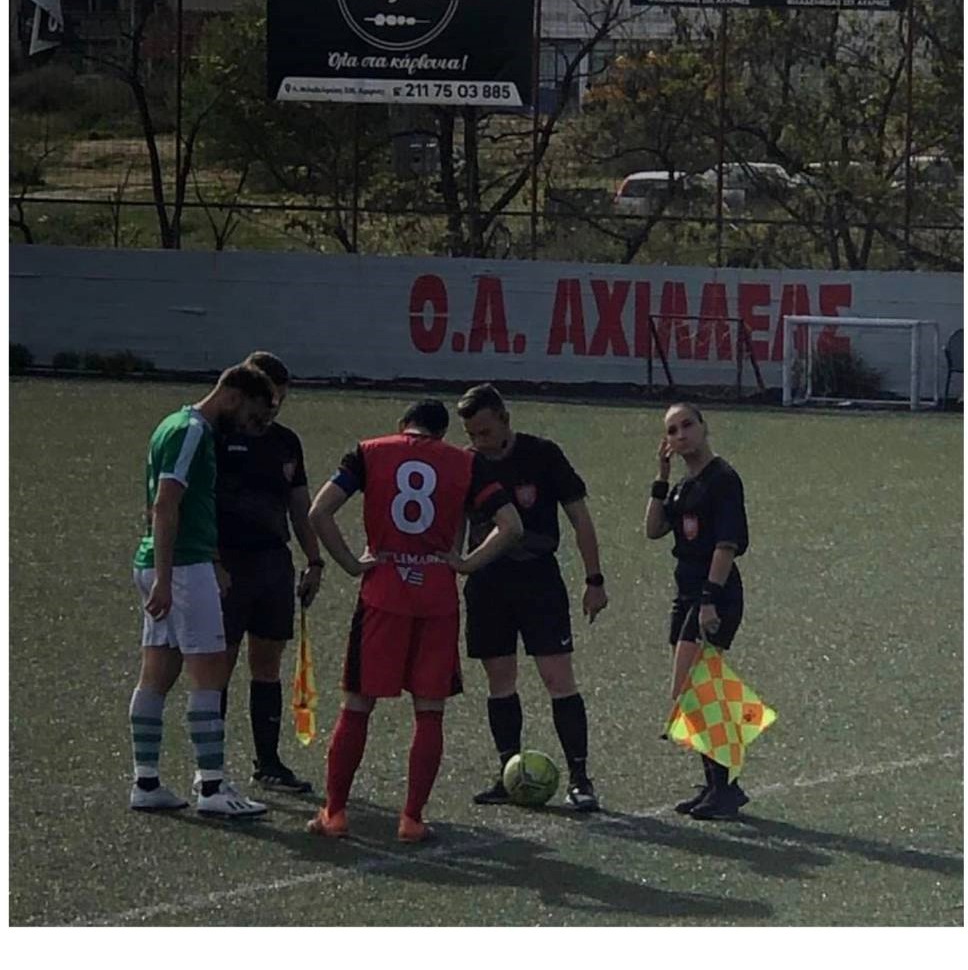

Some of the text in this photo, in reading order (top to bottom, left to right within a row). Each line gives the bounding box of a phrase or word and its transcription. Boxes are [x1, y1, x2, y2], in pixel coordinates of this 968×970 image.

[405, 83, 512, 100] 211 75 03 885
[391, 460, 437, 534] 8
